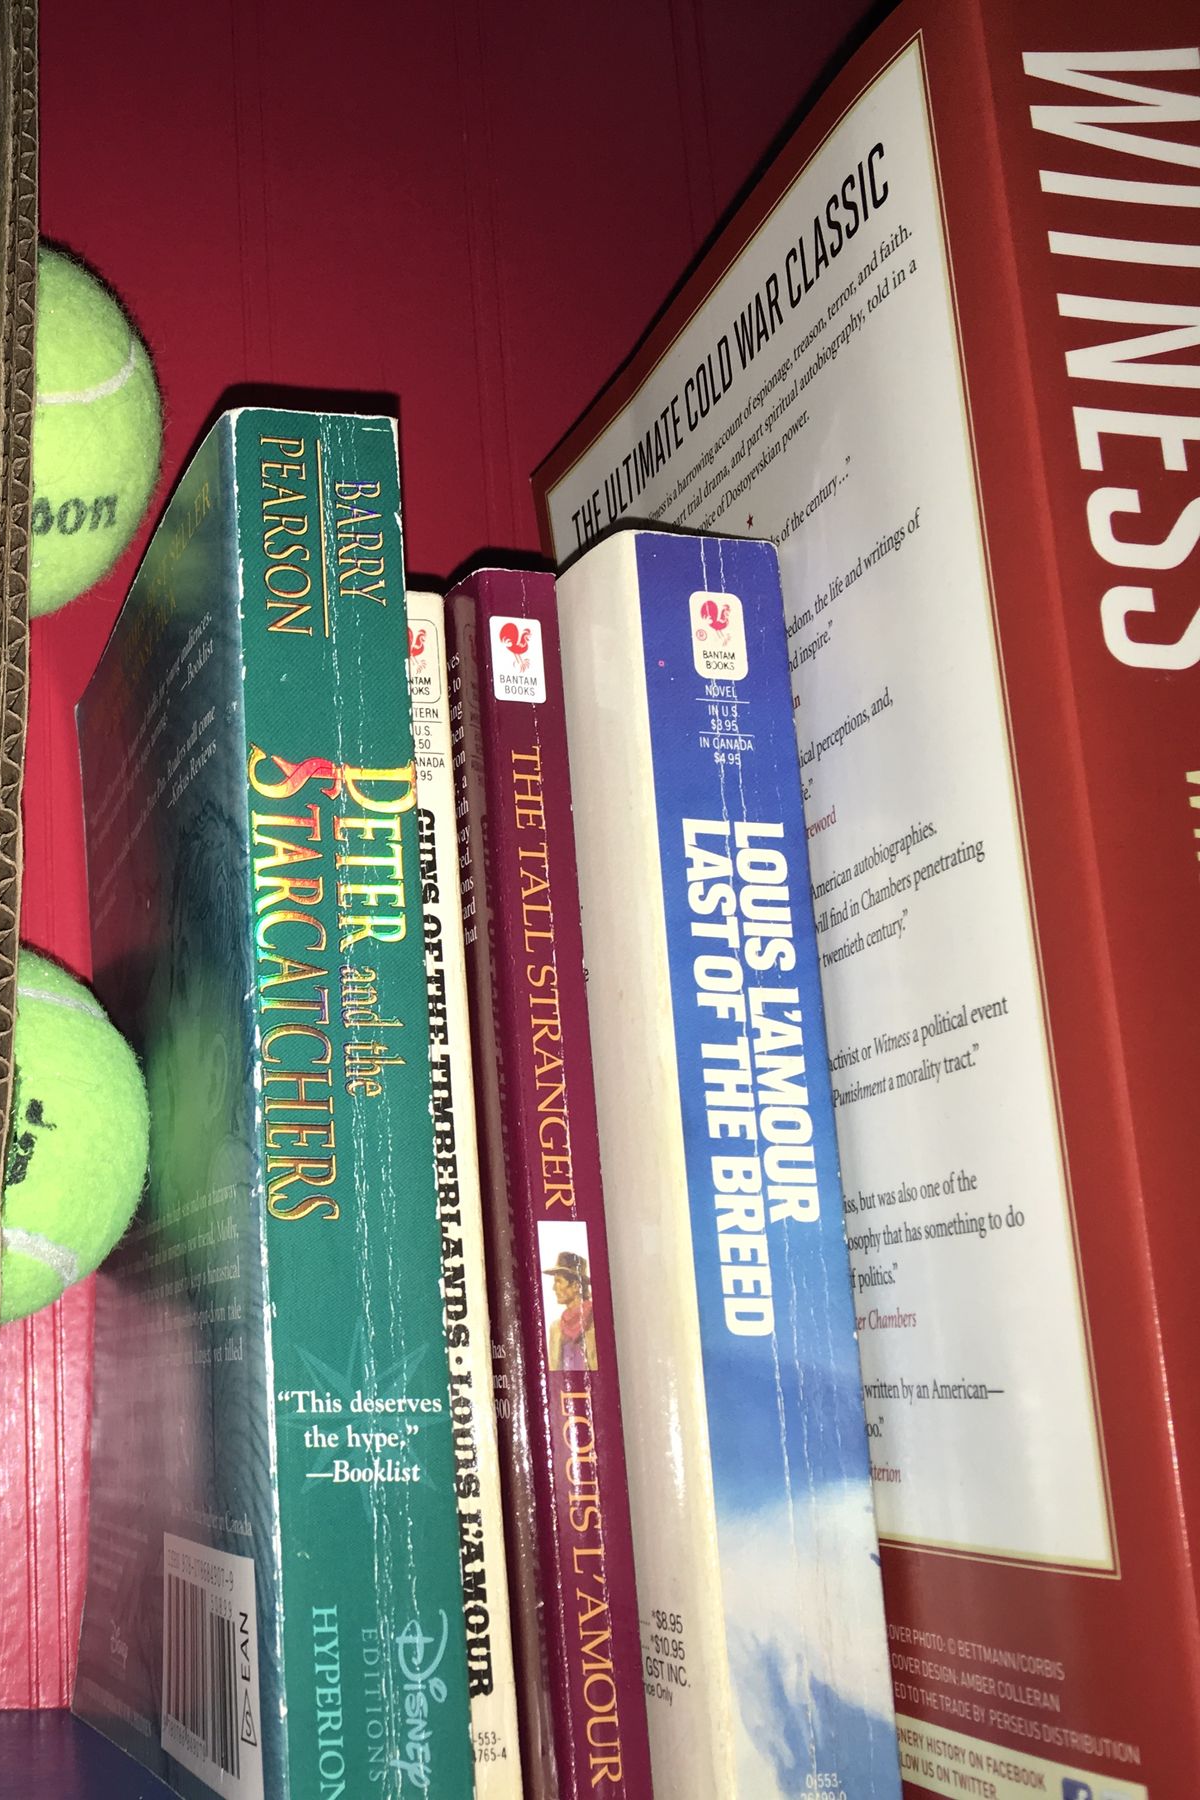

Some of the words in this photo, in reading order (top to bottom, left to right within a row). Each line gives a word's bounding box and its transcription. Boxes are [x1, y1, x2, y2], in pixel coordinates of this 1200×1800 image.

[572, 489, 601, 549] THE
[605, 395, 684, 524] ULTIMATE
[684, 334, 733, 432] COLD
[733, 272, 784, 371] WAR
[785, 142, 889, 309] CLASSIC
[677, 445, 715, 494] harrowing
[714, 414, 743, 454] account
[744, 397, 752, 419] of
[752, 357, 794, 410] espionage,
[794, 317, 828, 361] treason,
[827, 281, 857, 320] terror,
[858, 250, 879, 286] and
[880, 224, 912, 263] faith.
[687, 488, 702, 517] trial
[703, 465, 730, 498] drama,
[731, 440, 746, 469] and
[746, 425, 764, 455] part
[764, 379, 799, 433] spiritual
[799, 308, 866, 391] autobiography,
[867, 277, 890, 313] told
[892, 268, 906, 290] in
[909, 258, 917, 274] a
[716, 492, 726, 518] of
[725, 441, 781, 508] Dostoyevskian
[782, 410, 810, 452] power.
[260, 434, 313, 636] PEARSON
[335, 481, 387, 606] BARRY
[781, 517, 792, 542] of
[791, 511, 805, 533] the
[814, 594, 829, 615] the
[829, 576, 844, 603] life
[844, 558, 863, 588] and
[863, 526, 906, 571] writings
[907, 507, 921, 535] of
[500, 674, 538, 686] BANTAM
[505, 685, 536, 697] BOOKS
[703, 650, 735, 660] BANTAM
[705, 685, 737, 698] NOVEL
[706, 660, 735, 670] BOOKS
[699, 736, 710, 748] IN
[712, 737, 753, 751] CANADA
[708, 704, 718, 716] IN
[816, 708, 871, 761] perceptions,
[871, 686, 893, 717] and,
[190, 739, 217, 779] Reviews
[511, 745, 546, 830] THE
[333, 759, 417, 952] PETER
[418, 808, 440, 904] GUNS
[682, 818, 742, 949] LAST
[810, 867, 852, 900] American
[853, 821, 938, 878] autobiographies.
[829, 901, 849, 929] find
[849, 899, 860, 918] in
[860, 873, 911, 911] Chambers
[913, 840, 986, 892] penetrating
[518, 842, 554, 953] TALL
[734, 821, 796, 973] LOUIS
[423, 914, 445, 967] OF
[822, 932, 865, 968] twentieth
[248, 743, 343, 1221] STARCATCHERS
[339, 964, 404, 1028] and
[427, 969, 448, 1045] THE
[694, 956, 746, 1023] OF
[343, 1041, 406, 1097] the
[829, 1047, 860, 1072] activist
[862, 1046, 871, 1060] or
[873, 1030, 910, 1056] Witness
[912, 1028, 919, 1043] a
[921, 1004, 968, 1046] political
[970, 997, 1009, 1024] event
[526, 964, 577, 1211] STRANGER
[699, 1034, 757, 1142] THE
[749, 986, 820, 1226] L'AMOUR
[832, 1075, 887, 1108] Punishment
[888, 1076, 894, 1091] a
[895, 1056, 942, 1089] morality
[431, 1054, 470, 1348] TIMBERLANDS
[860, 1191, 876, 1211] but
[877, 1190, 896, 1207] was
[898, 1181, 918, 1205] also
[920, 1181, 940, 1198] one
[942, 1171, 956, 1195] of
[957, 1169, 977, 1193] the
[883, 1223, 903, 1246] that
[904, 1222, 922, 1243] has
[924, 1211, 987, 1240] something
[988, 1211, 1002, 1230] to
[1005, 1204, 1025, 1229] do
[712, 1155, 775, 1337] BREED
[868, 1307, 917, 1331] Chambers
[350, 1390, 442, 1413] deserves
[864, 1379, 900, 1400] written
[901, 1377, 914, 1405] by
[916, 1384, 930, 1400] an
[304, 1425, 338, 1447] the
[450, 1371, 481, 1499] LOUIS
[559, 1388, 602, 1534] LOUIS
[458, 1508, 494, 1699] L'AMOUR
[239, 1611, 251, 1682] EAN
[571, 1544, 624, 1788] L'AMOUR
[646, 1656, 664, 1680] GST
[667, 1663, 691, 1688] INC.
[888, 1624, 916, 1645] OVER
[913, 1629, 945, 1652] PHOTO:
[958, 1640, 1066, 1681] BETTMANN/CORBIS
[892, 1653, 921, 1675] COVER
[922, 1661, 960, 1686] DESIGN:
[960, 1672, 997, 1697] AMBER
[997, 1681, 1061, 1712] COLLERAN
[312, 1605, 346, 1800] HYPERION
[361, 1628, 384, 1782] EDITIONS
[656, 1683, 673, 1707] Only
[907, 1685, 919, 1704] TO
[919, 1689, 939, 1710] THE
[938, 1695, 972, 1720] TRADE
[973, 1705, 985, 1723] BY
[989, 1709, 1042, 1741] PERSEUS
[1042, 1723, 1141, 1765] DISTRIBUTION
[922, 1758, 935, 1778] US
[936, 1763, 950, 1783] ON
[951, 1769, 997, 1800] TWITTER
[926, 1736, 966, 1765] HISTORY
[969, 1750, 984, 1770] ON
[985, 1756, 1047, 1792] FACEBOOK
